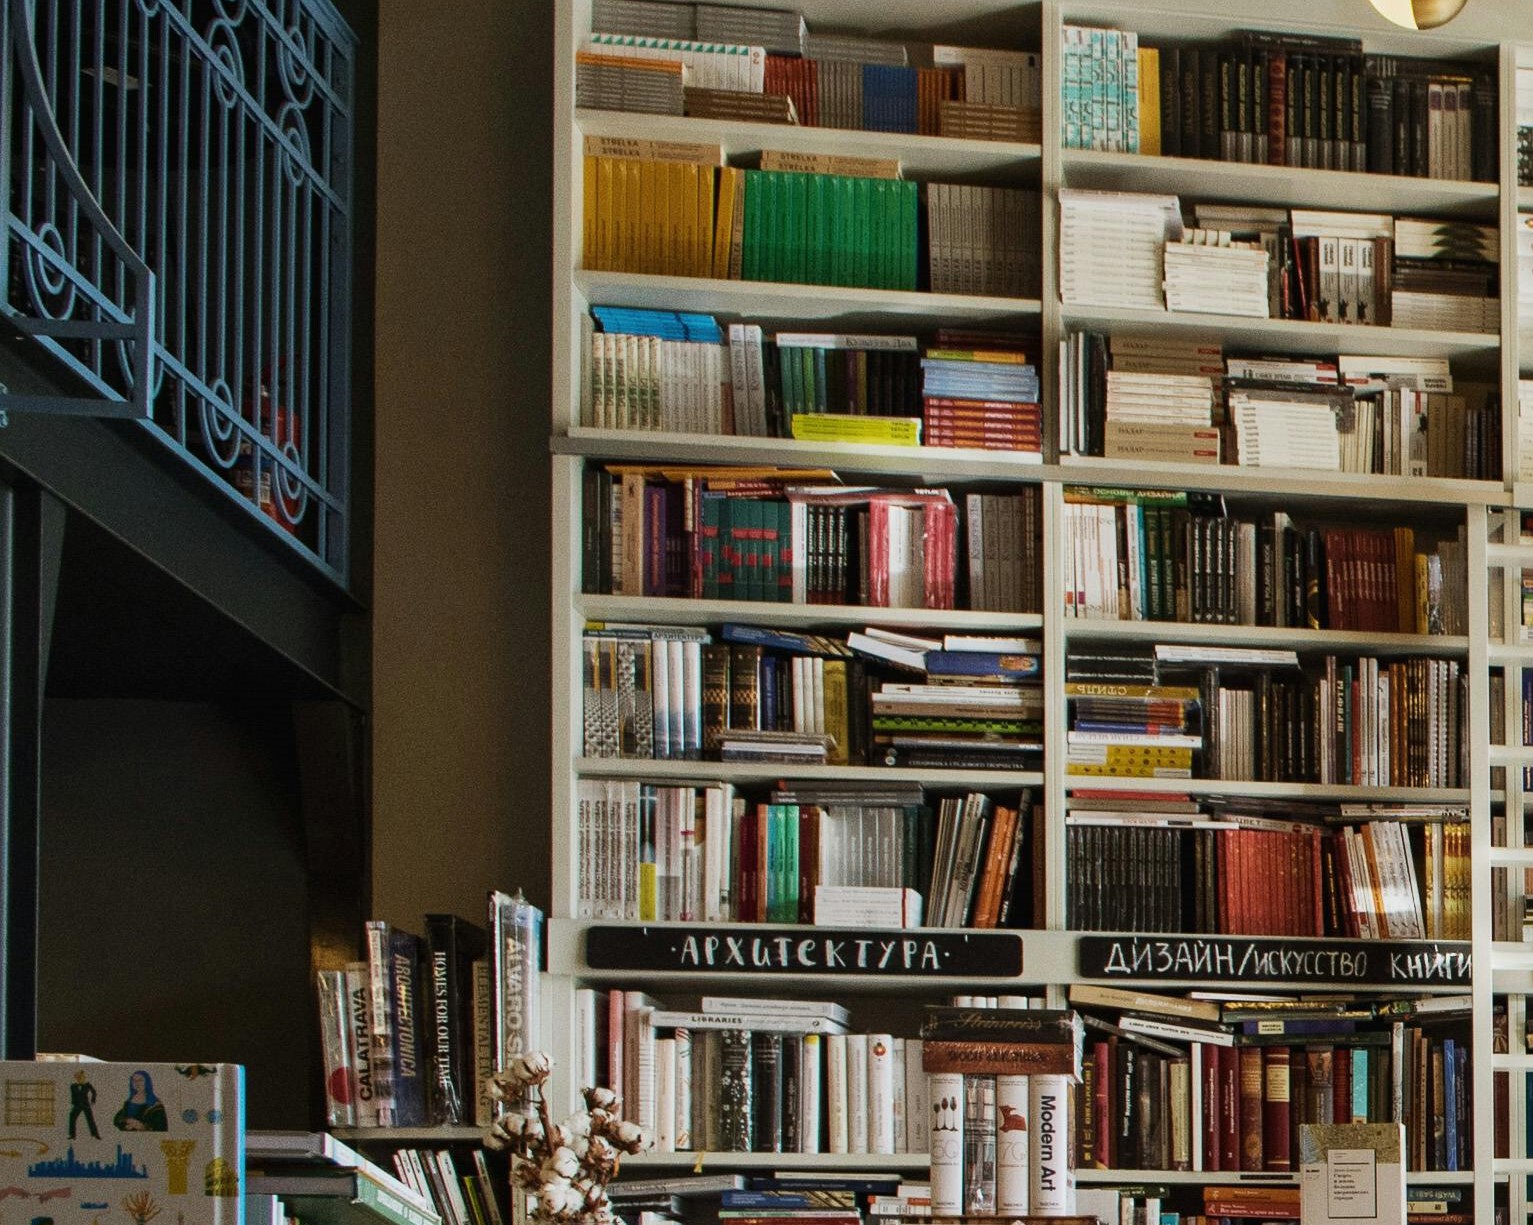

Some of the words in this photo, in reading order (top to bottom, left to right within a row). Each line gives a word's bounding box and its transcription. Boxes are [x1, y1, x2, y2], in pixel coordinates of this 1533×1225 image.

[434, 951, 448, 1000] HOMES
[435, 1002, 449, 1024] FOR
[691, 1016, 743, 1025] LIBRARIES
[352, 986, 375, 1102] CALATRAVA
[436, 1026, 450, 1054] OUR
[1039, 1095, 1057, 1162] Modern
[1042, 1167, 1057, 1192] Art
